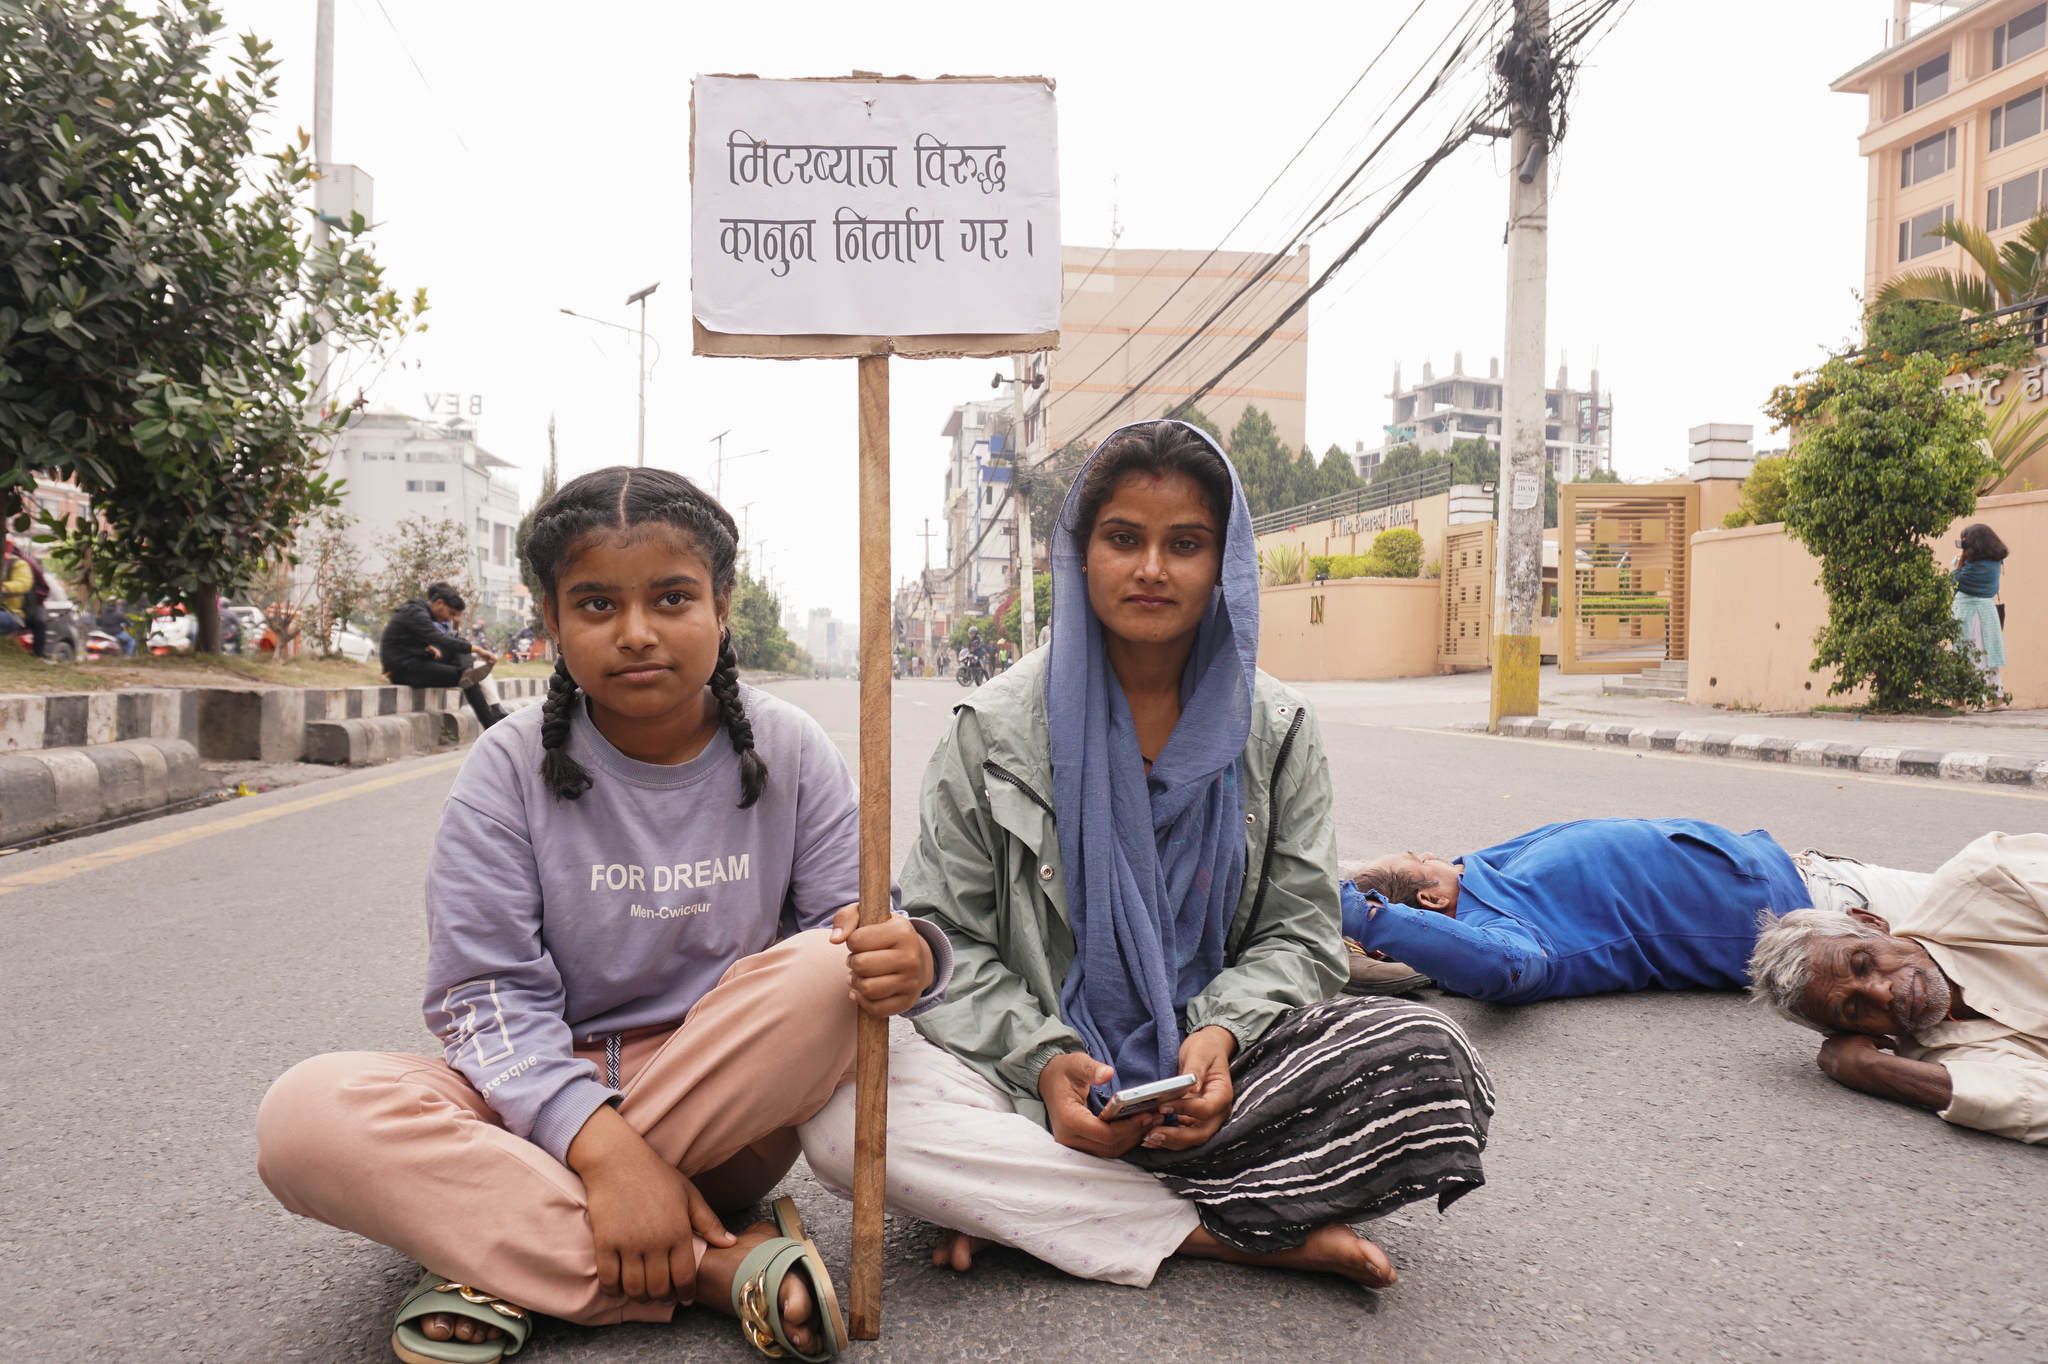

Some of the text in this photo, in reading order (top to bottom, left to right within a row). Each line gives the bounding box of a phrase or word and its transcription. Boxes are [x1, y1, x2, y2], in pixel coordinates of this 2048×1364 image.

[727, 129, 1006, 194] मिटरब्याज विरुद्ध
[719, 218, 816, 277] कानुन
[833, 206, 944, 263] निर्माण
[1336, 501, 1413, 537] The Everest Hotel
[1310, 595, 1325, 624] IN
[590, 853, 750, 893] FOR DREAM
